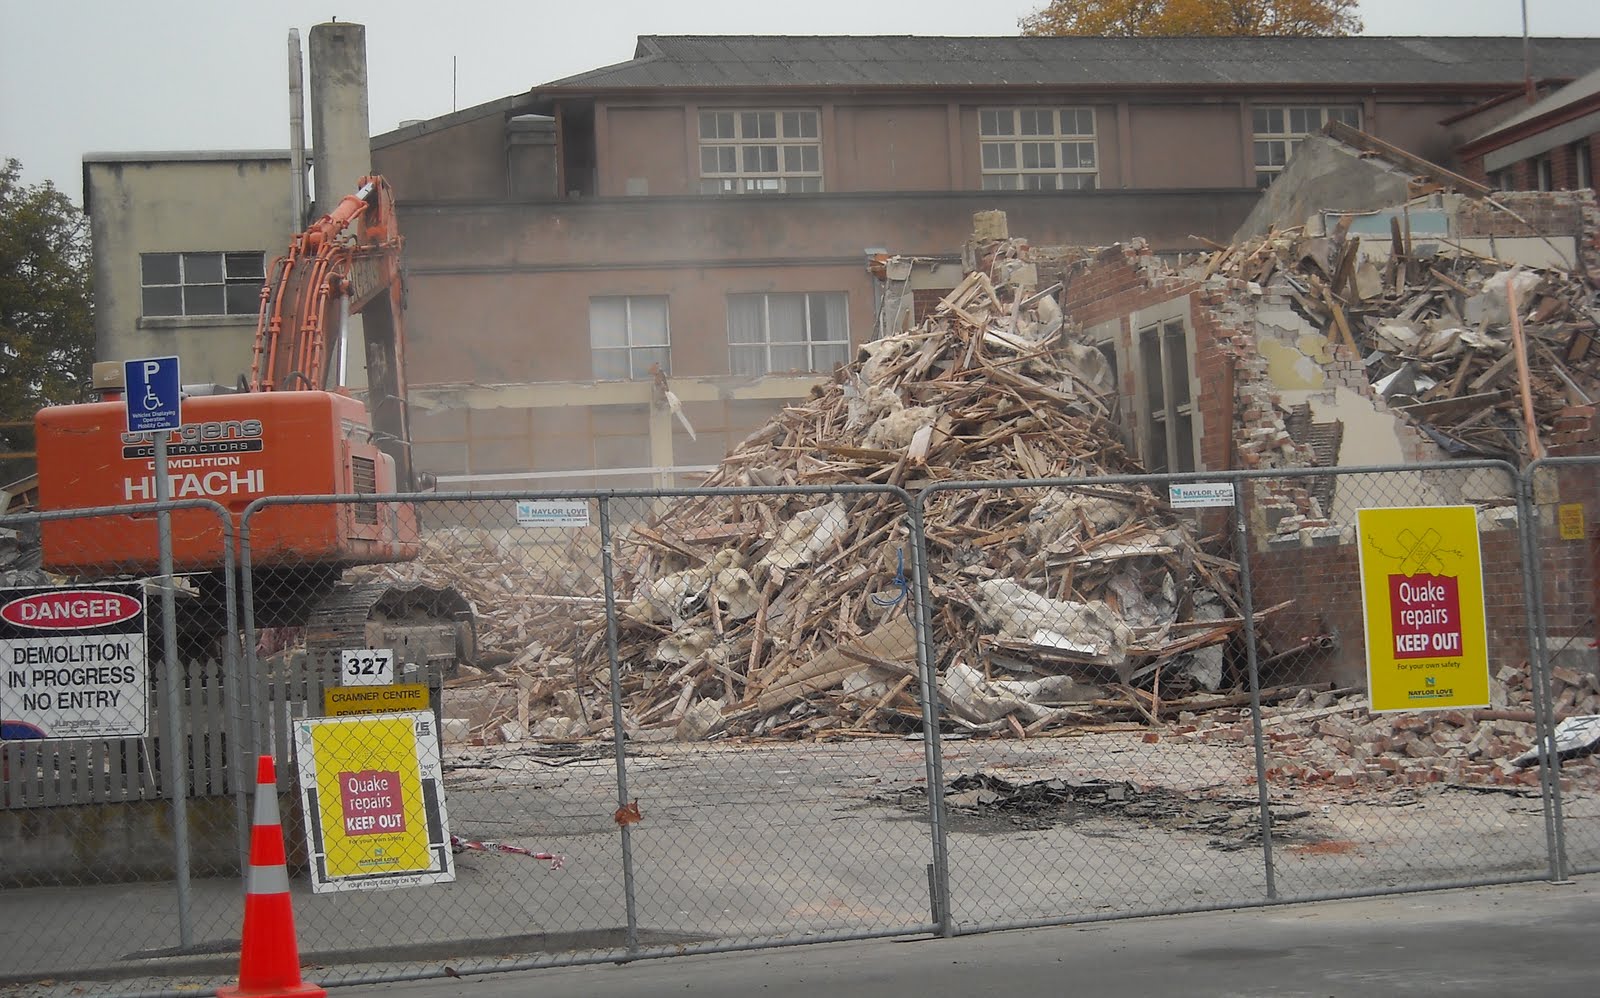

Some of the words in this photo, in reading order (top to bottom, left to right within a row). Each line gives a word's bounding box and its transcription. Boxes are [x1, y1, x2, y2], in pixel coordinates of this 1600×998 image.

[143, 361, 160, 384] P
[121, 419, 263, 446] Jrgens
[137, 442, 248, 456] COTRACTORS
[147, 456, 240, 470] DMOLITION
[124, 469, 264, 500] HITACHI
[1399, 580, 1445, 605] Quake
[21, 599, 121, 620] DANGER
[1400, 604, 1448, 629] repairs
[1396, 634, 1429, 652] KEEP
[1432, 632, 1459, 650] OUT
[13, 643, 129, 665] DEMOLITION
[348, 658, 388, 675] 327
[1409, 663, 1424, 671] your
[1440, 661, 1461, 669] safety
[8, 671, 26, 688] IN
[32, 665, 136, 687] PROGRESS
[23, 693, 51, 711] NO
[57, 690, 121, 709] ENTRY
[382, 690, 420, 699] CENTRE
[348, 776, 389, 795] Quake
[350, 793, 392, 813] repairs
[346, 815, 376, 832] KEEP
[378, 813, 402, 828] OUT
